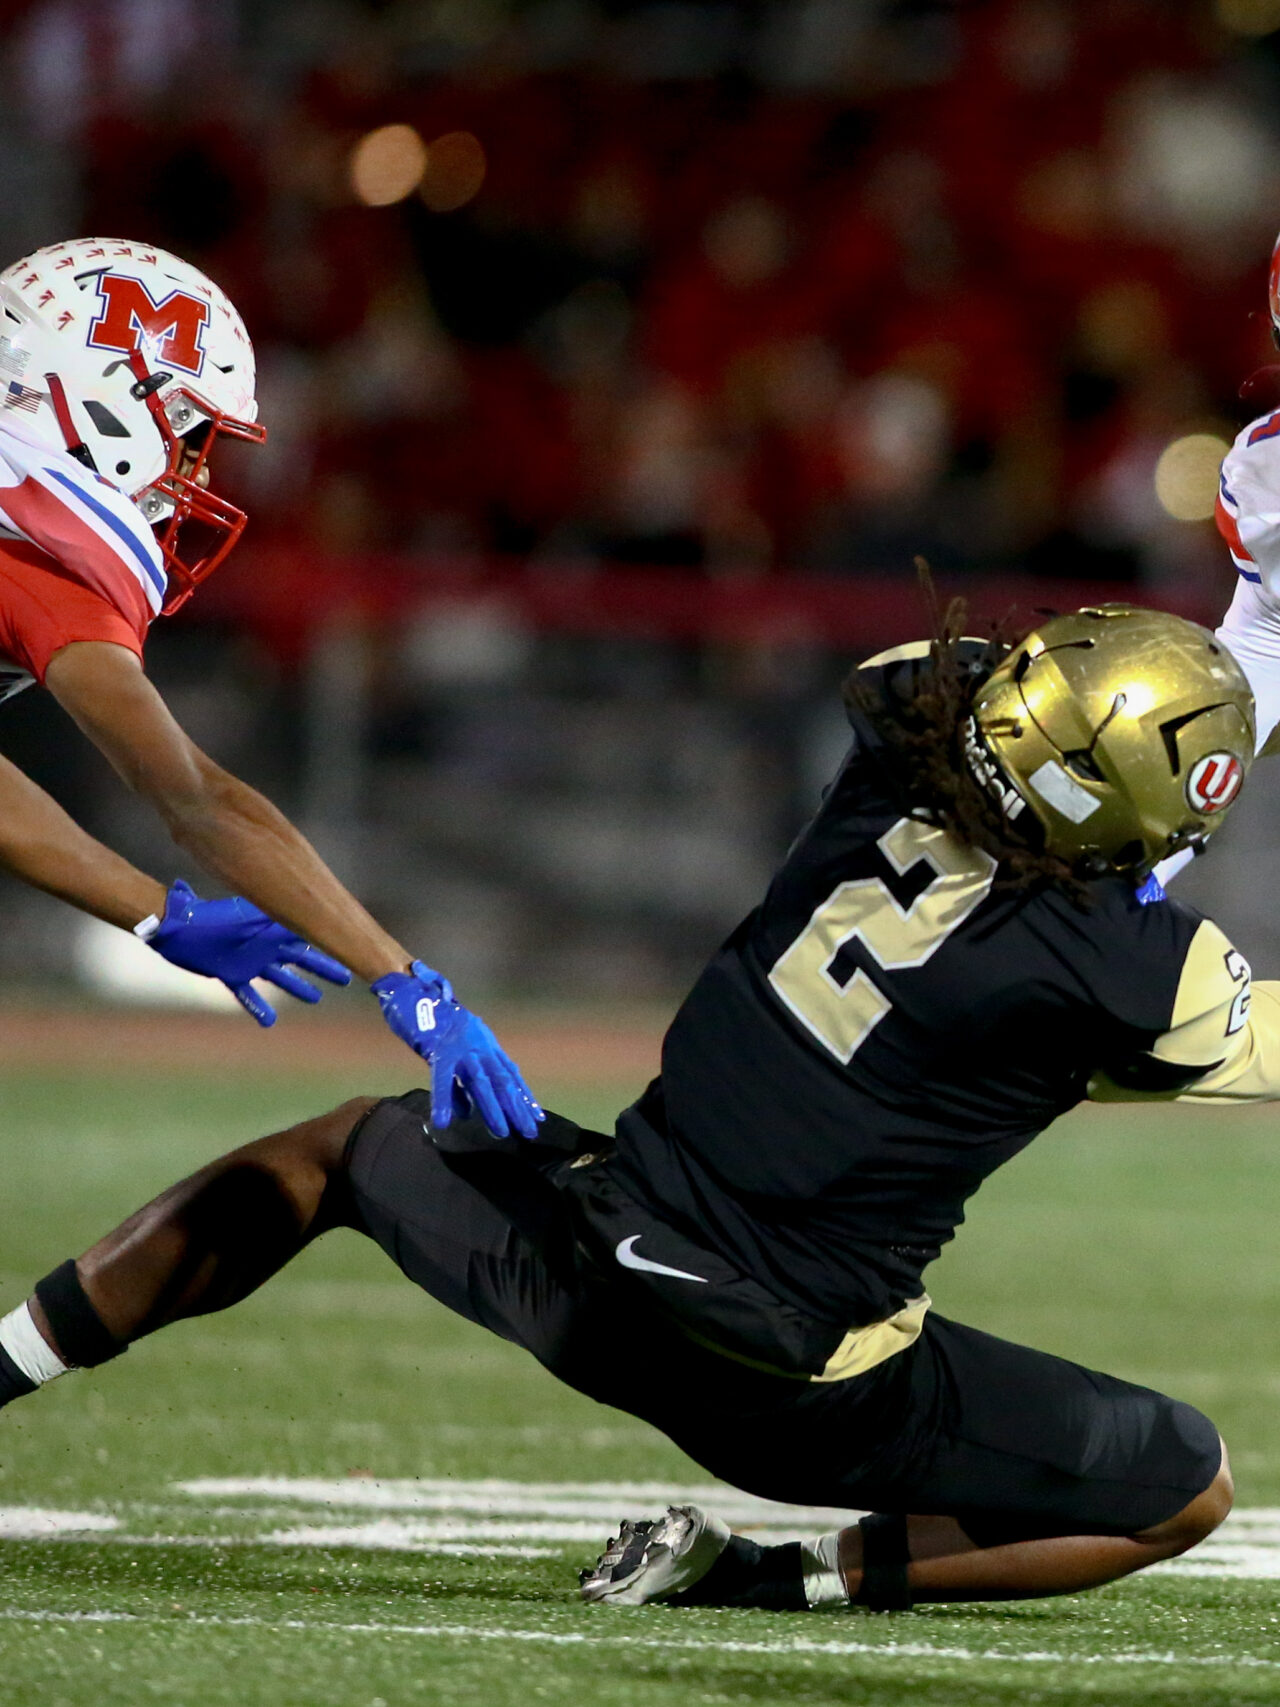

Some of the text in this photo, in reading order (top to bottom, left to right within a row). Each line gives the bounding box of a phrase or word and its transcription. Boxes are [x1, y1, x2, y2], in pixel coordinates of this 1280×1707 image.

[86, 272, 211, 377] M
[768, 807, 999, 1066] 2
[1223, 948, 1252, 1038] 2
